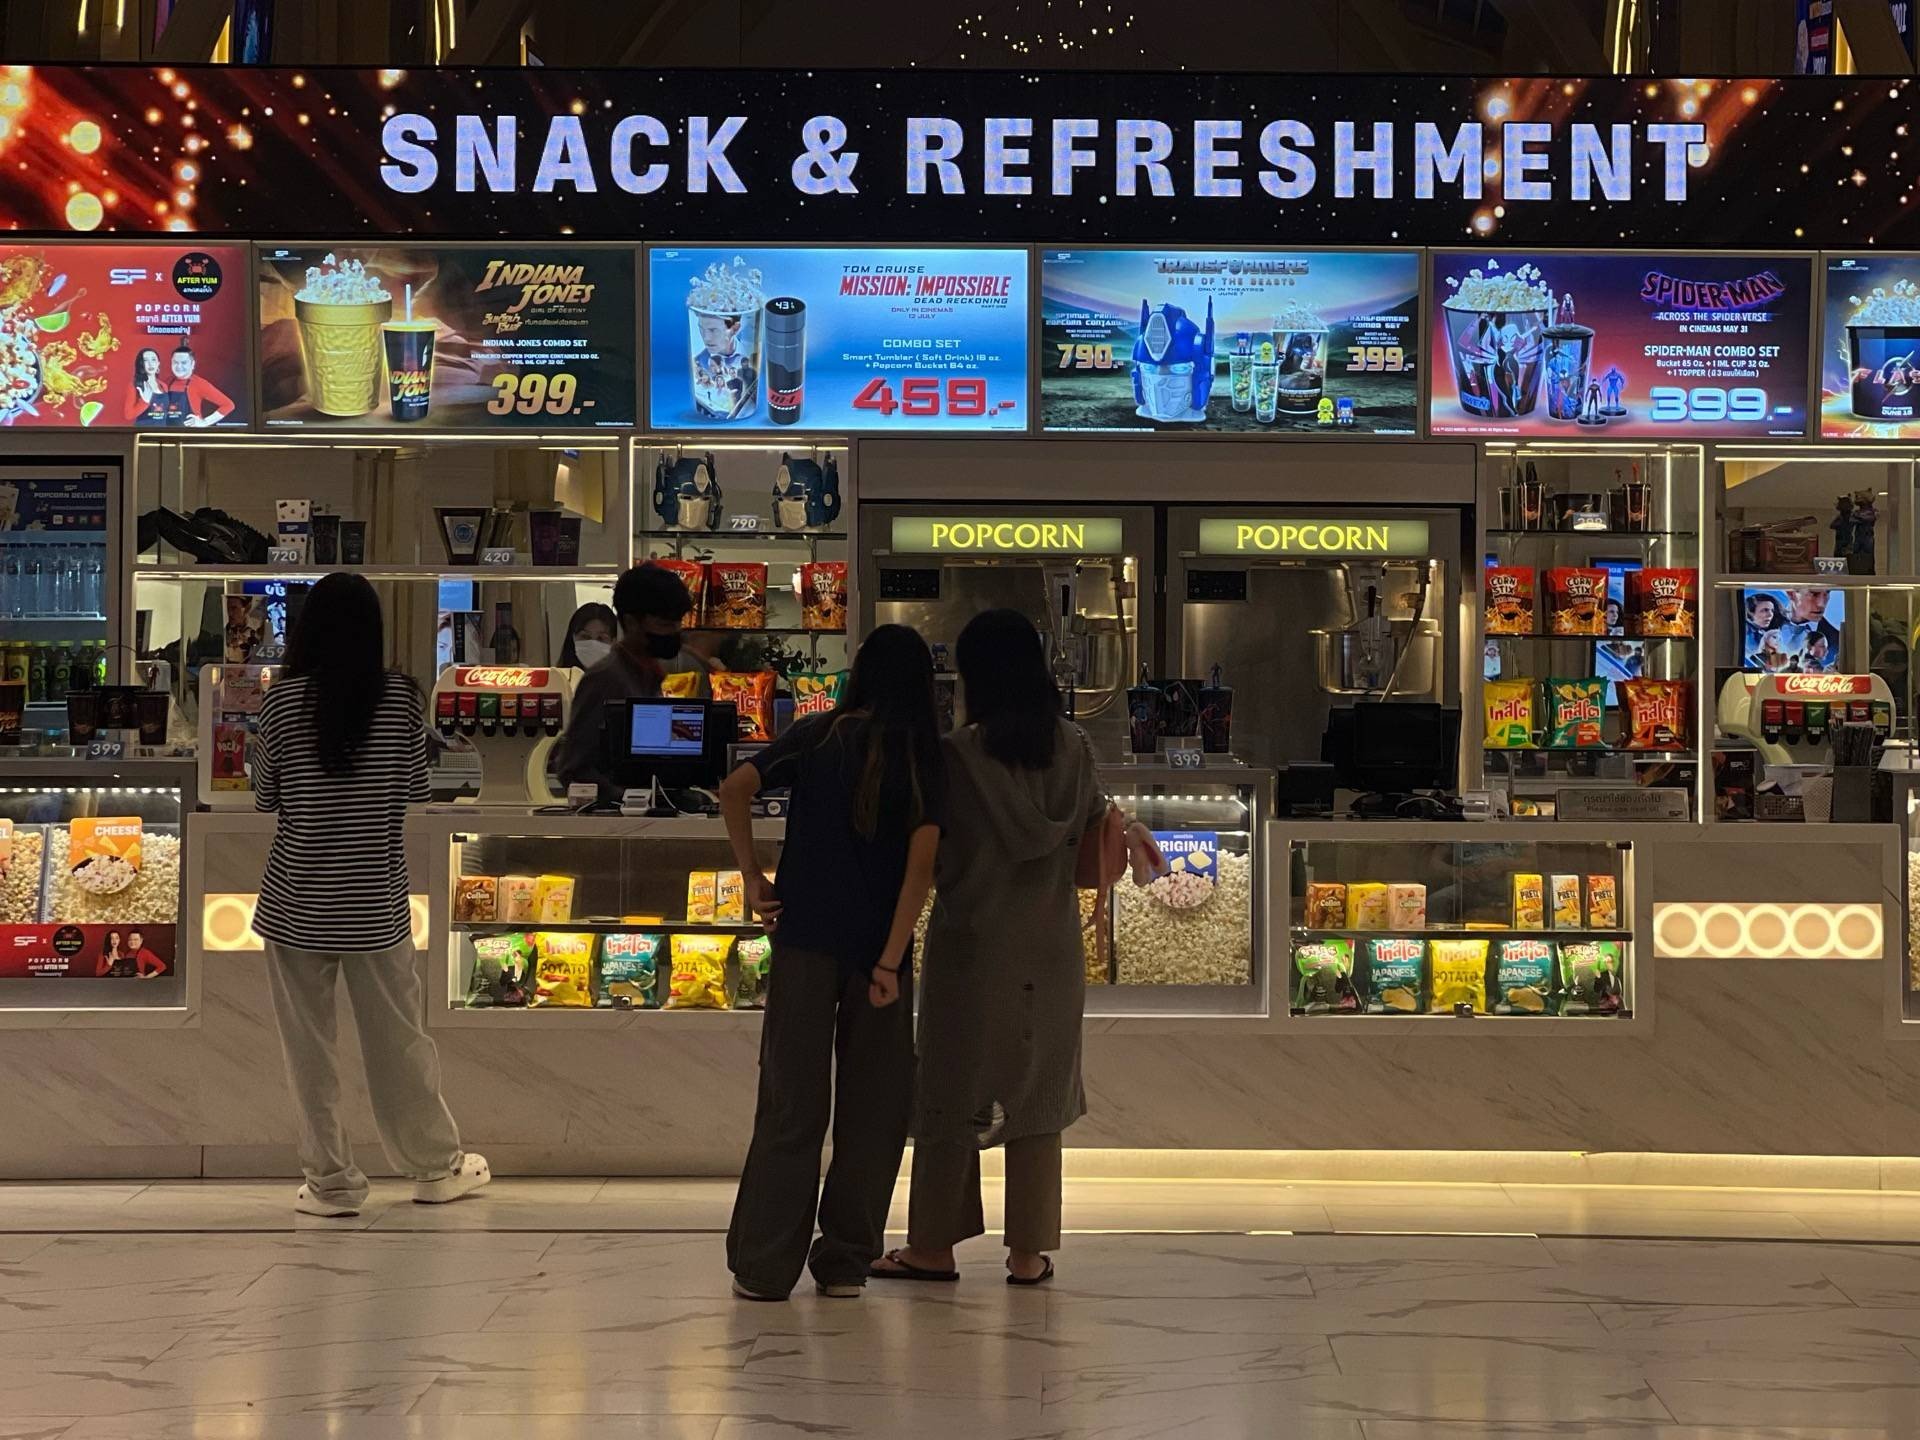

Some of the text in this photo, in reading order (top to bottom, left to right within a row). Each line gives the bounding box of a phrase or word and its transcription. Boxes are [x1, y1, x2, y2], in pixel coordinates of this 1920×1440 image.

[380, 113, 1708, 202] SNACK & REFRESHMENT
[1154, 258, 1309, 275] TRANSFORMERS
[110, 269, 147, 285] SF
[474, 261, 585, 293] INDIANA
[839, 276, 1011, 296] MISSION: IMPOSSIBLE
[1641, 271, 1785, 309] SPIDER-MAN
[506, 284, 596, 314] JONES
[135, 304, 200, 312] POPCORN
[161, 314, 182, 323] AFTER
[183, 314, 200, 323] YUM
[1656, 312, 1767, 322] ACROSS THE SPIDER-VERSE
[1680, 325, 1748, 333] IN CINEMAS MAY 31
[883, 339, 961, 348] COMBO SET
[1057, 344, 1124, 368] 790.-
[1644, 345, 1780, 357] SPIDER-MAN COMBO SET
[1346, 346, 1415, 371] 399.-
[487, 374, 595, 415] 399.-
[853, 378, 1015, 416] 459.-
[1651, 387, 1793, 421] 399.-
[731, 518, 757, 529] 790
[932, 523, 1085, 549] POPCORN
[1237, 525, 1389, 551] POPCORN
[271, 551, 297, 561] 720
[484, 552, 510, 562] 420
[1818, 561, 1844, 571] 999
[722, 571, 748, 581] CORN
[1490, 576, 1517, 587] CORN
[724, 581, 747, 591] STIX
[1566, 577, 1592, 587] CORN
[1651, 578, 1679, 588] CORN
[1493, 586, 1515, 596] STIX
[1569, 586, 1591, 596] STIX
[1654, 587, 1676, 597] STIX
[256, 647, 286, 658] 459
[464, 668, 531, 687] Coca-Cola
[1785, 675, 1853, 693] Coca-Cola
[91, 743, 120, 755] 399
[1174, 754, 1200, 766] 399
[95, 825, 139, 836] CHEESE
[1520, 890, 1540, 900] PRETZ
[1557, 890, 1577, 900] PRETZ
[1593, 890, 1613, 900] PRETZ
[13, 936, 38, 947] SF
[541, 964, 585, 975] POTATO
[602, 962, 643, 971] JAPANESE
[1372, 968, 1416, 977] JAPANESE
[1434, 971, 1478, 982] POTATO
[1498, 968, 1542, 978] JAPANESE
